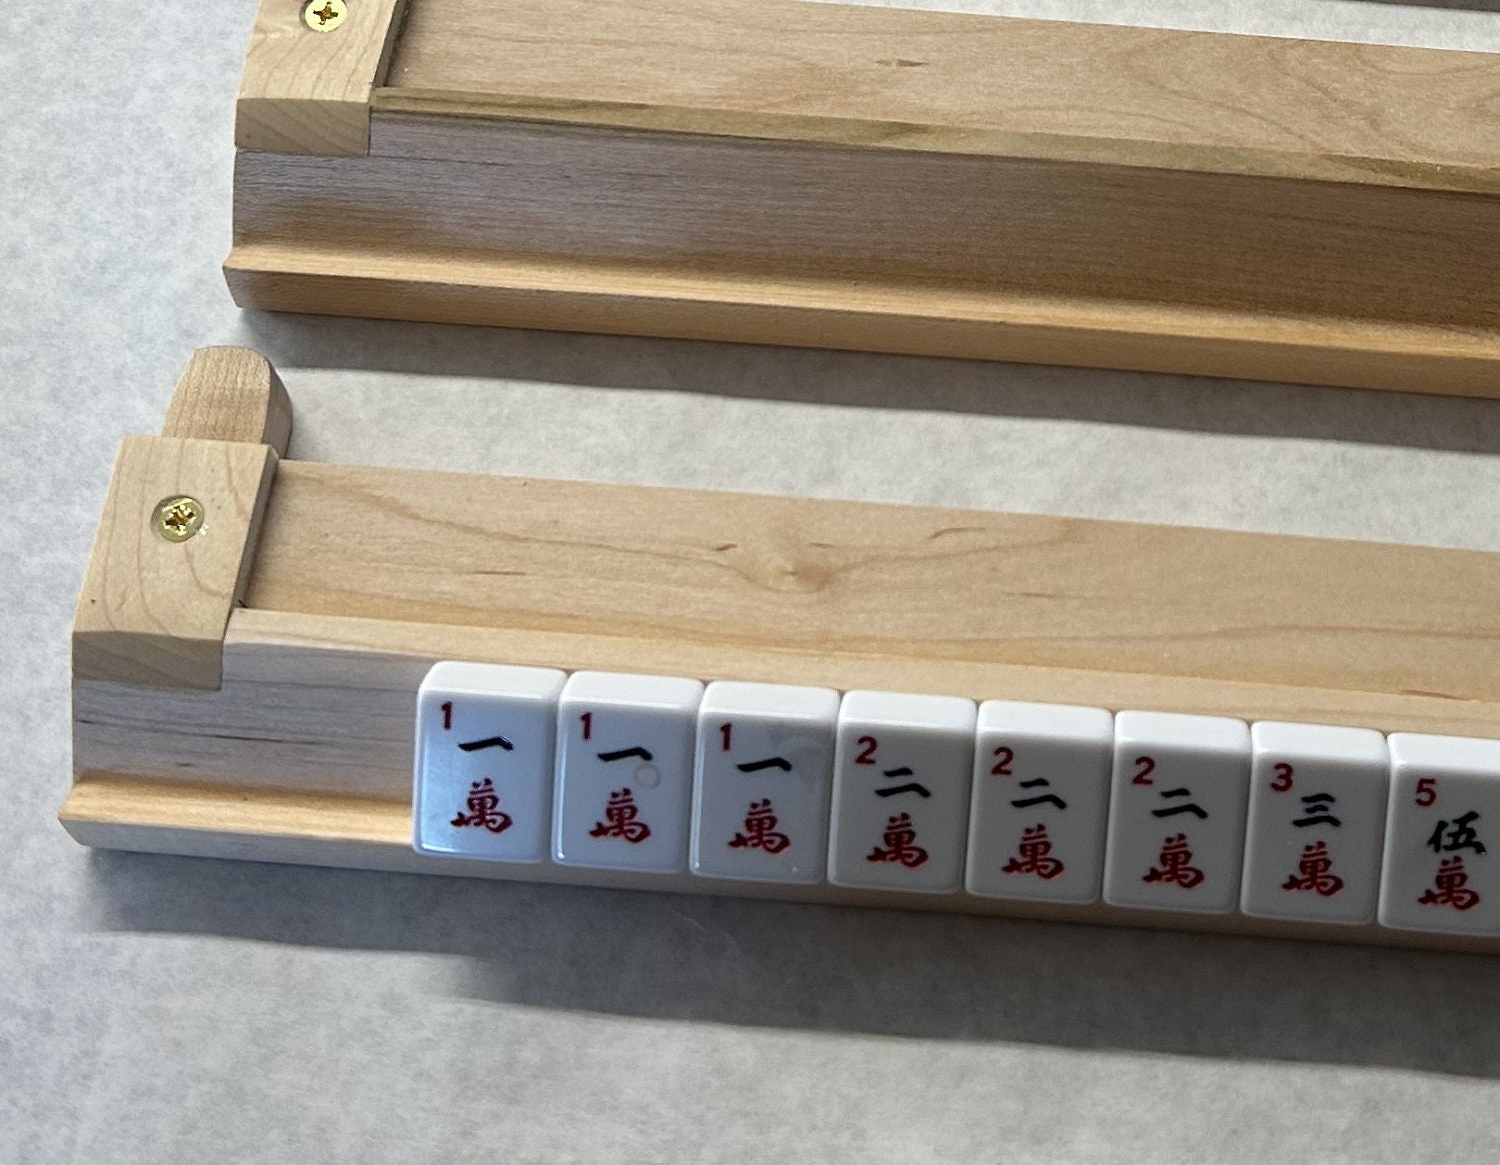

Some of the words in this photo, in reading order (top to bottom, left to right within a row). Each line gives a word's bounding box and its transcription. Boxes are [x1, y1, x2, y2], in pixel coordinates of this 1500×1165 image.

[440, 702, 453, 730] 1
[580, 712, 593, 741] 1
[719, 723, 733, 753] 1
[854, 735, 879, 768] 2
[990, 746, 1015, 778] 2
[1131, 755, 1157, 788] 2
[1270, 761, 1296, 796] 3
[1415, 776, 1438, 809] 5
